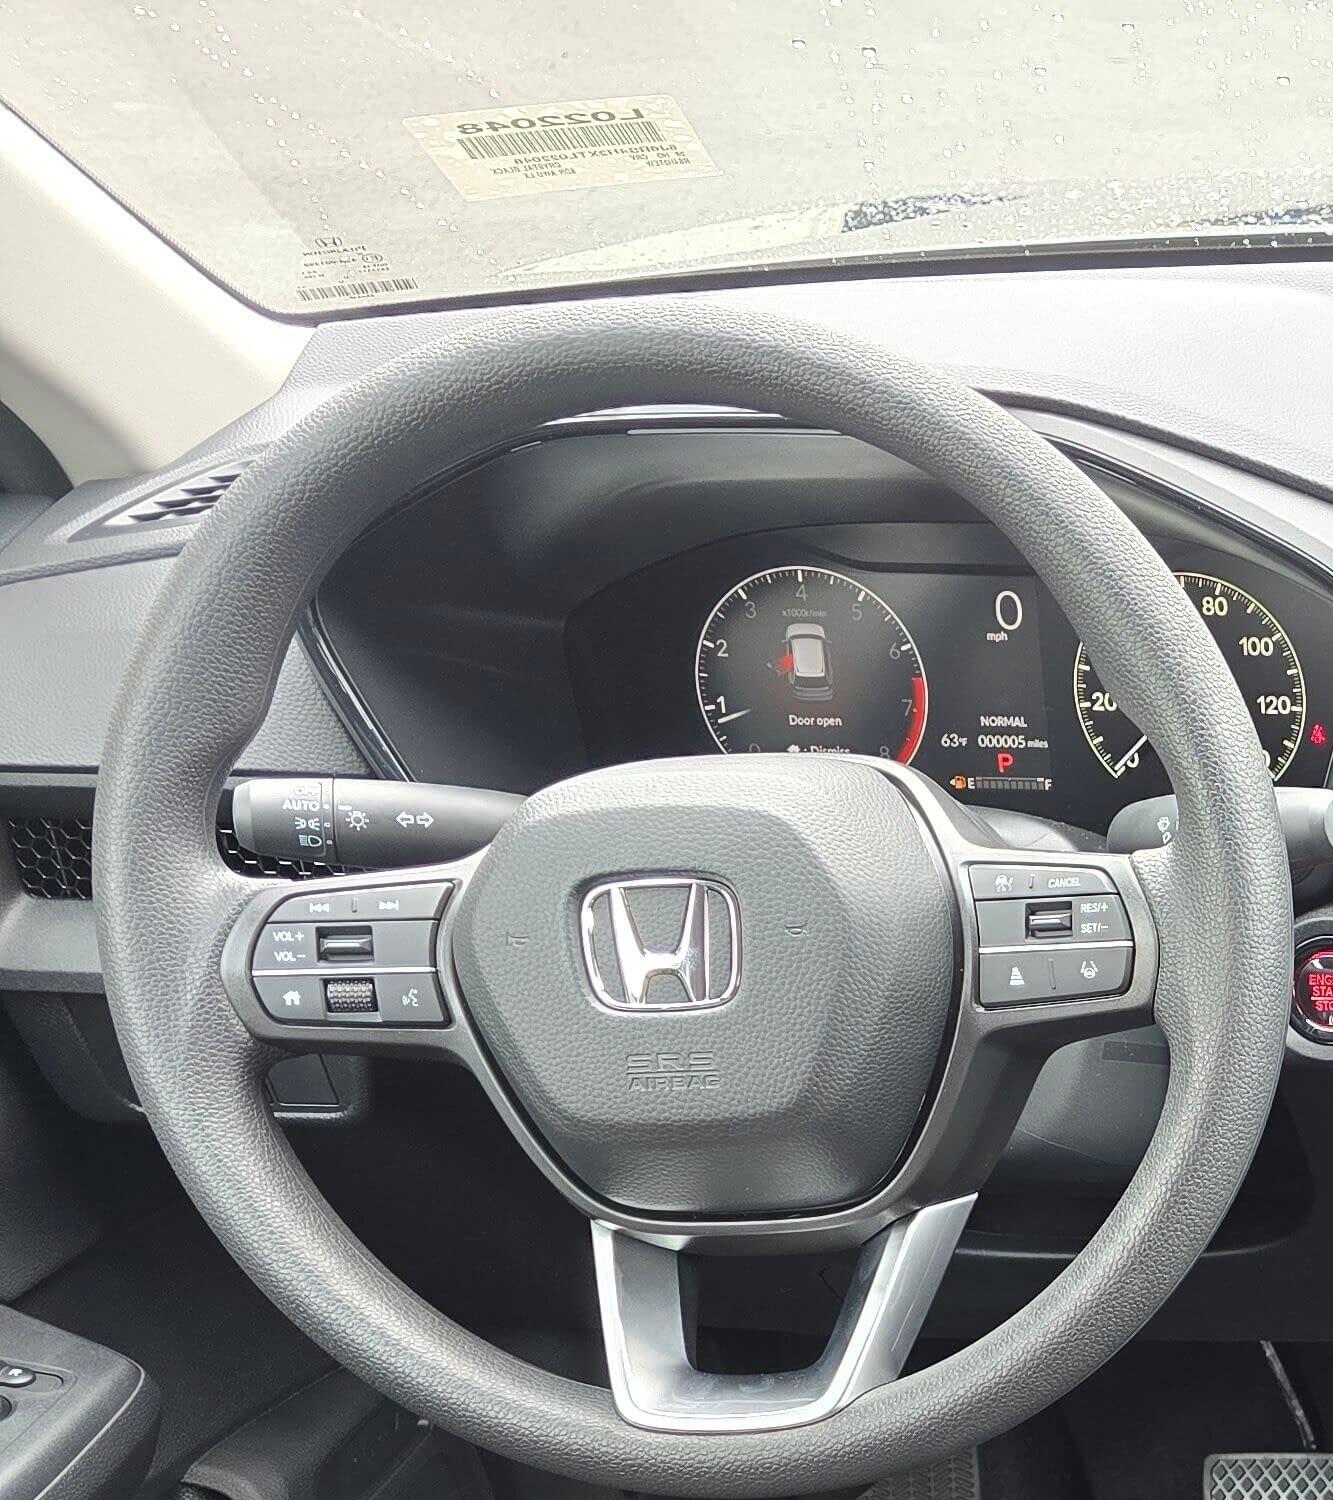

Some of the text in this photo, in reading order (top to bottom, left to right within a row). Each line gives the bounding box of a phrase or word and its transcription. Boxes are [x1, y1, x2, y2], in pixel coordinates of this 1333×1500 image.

[795, 585, 808, 601] 4
[745, 601, 757, 619] 3
[851, 603, 863, 621] 5
[995, 590, 1023, 631] 0
[1202, 597, 1228, 616] 80
[986, 631, 1008, 642] mph
[716, 639, 729, 658] 2
[889, 642, 901, 660] 6
[1238, 636, 1274, 657] 100
[716, 695, 726, 714] 1
[901, 699, 913, 717] 7
[1256, 696, 1291, 715] 120
[788, 714, 842, 728] Door open
[980, 715, 1028, 728] NORMAL
[977, 734, 1026, 748] 000005
[1027, 738, 1049, 748] miles
[997, 753, 1014, 773] P
[967, 777, 976, 789] E
[1044, 778, 1053, 790] F
[282, 799, 320, 812] AUTO
[1047, 877, 1081, 888] CANCEL
